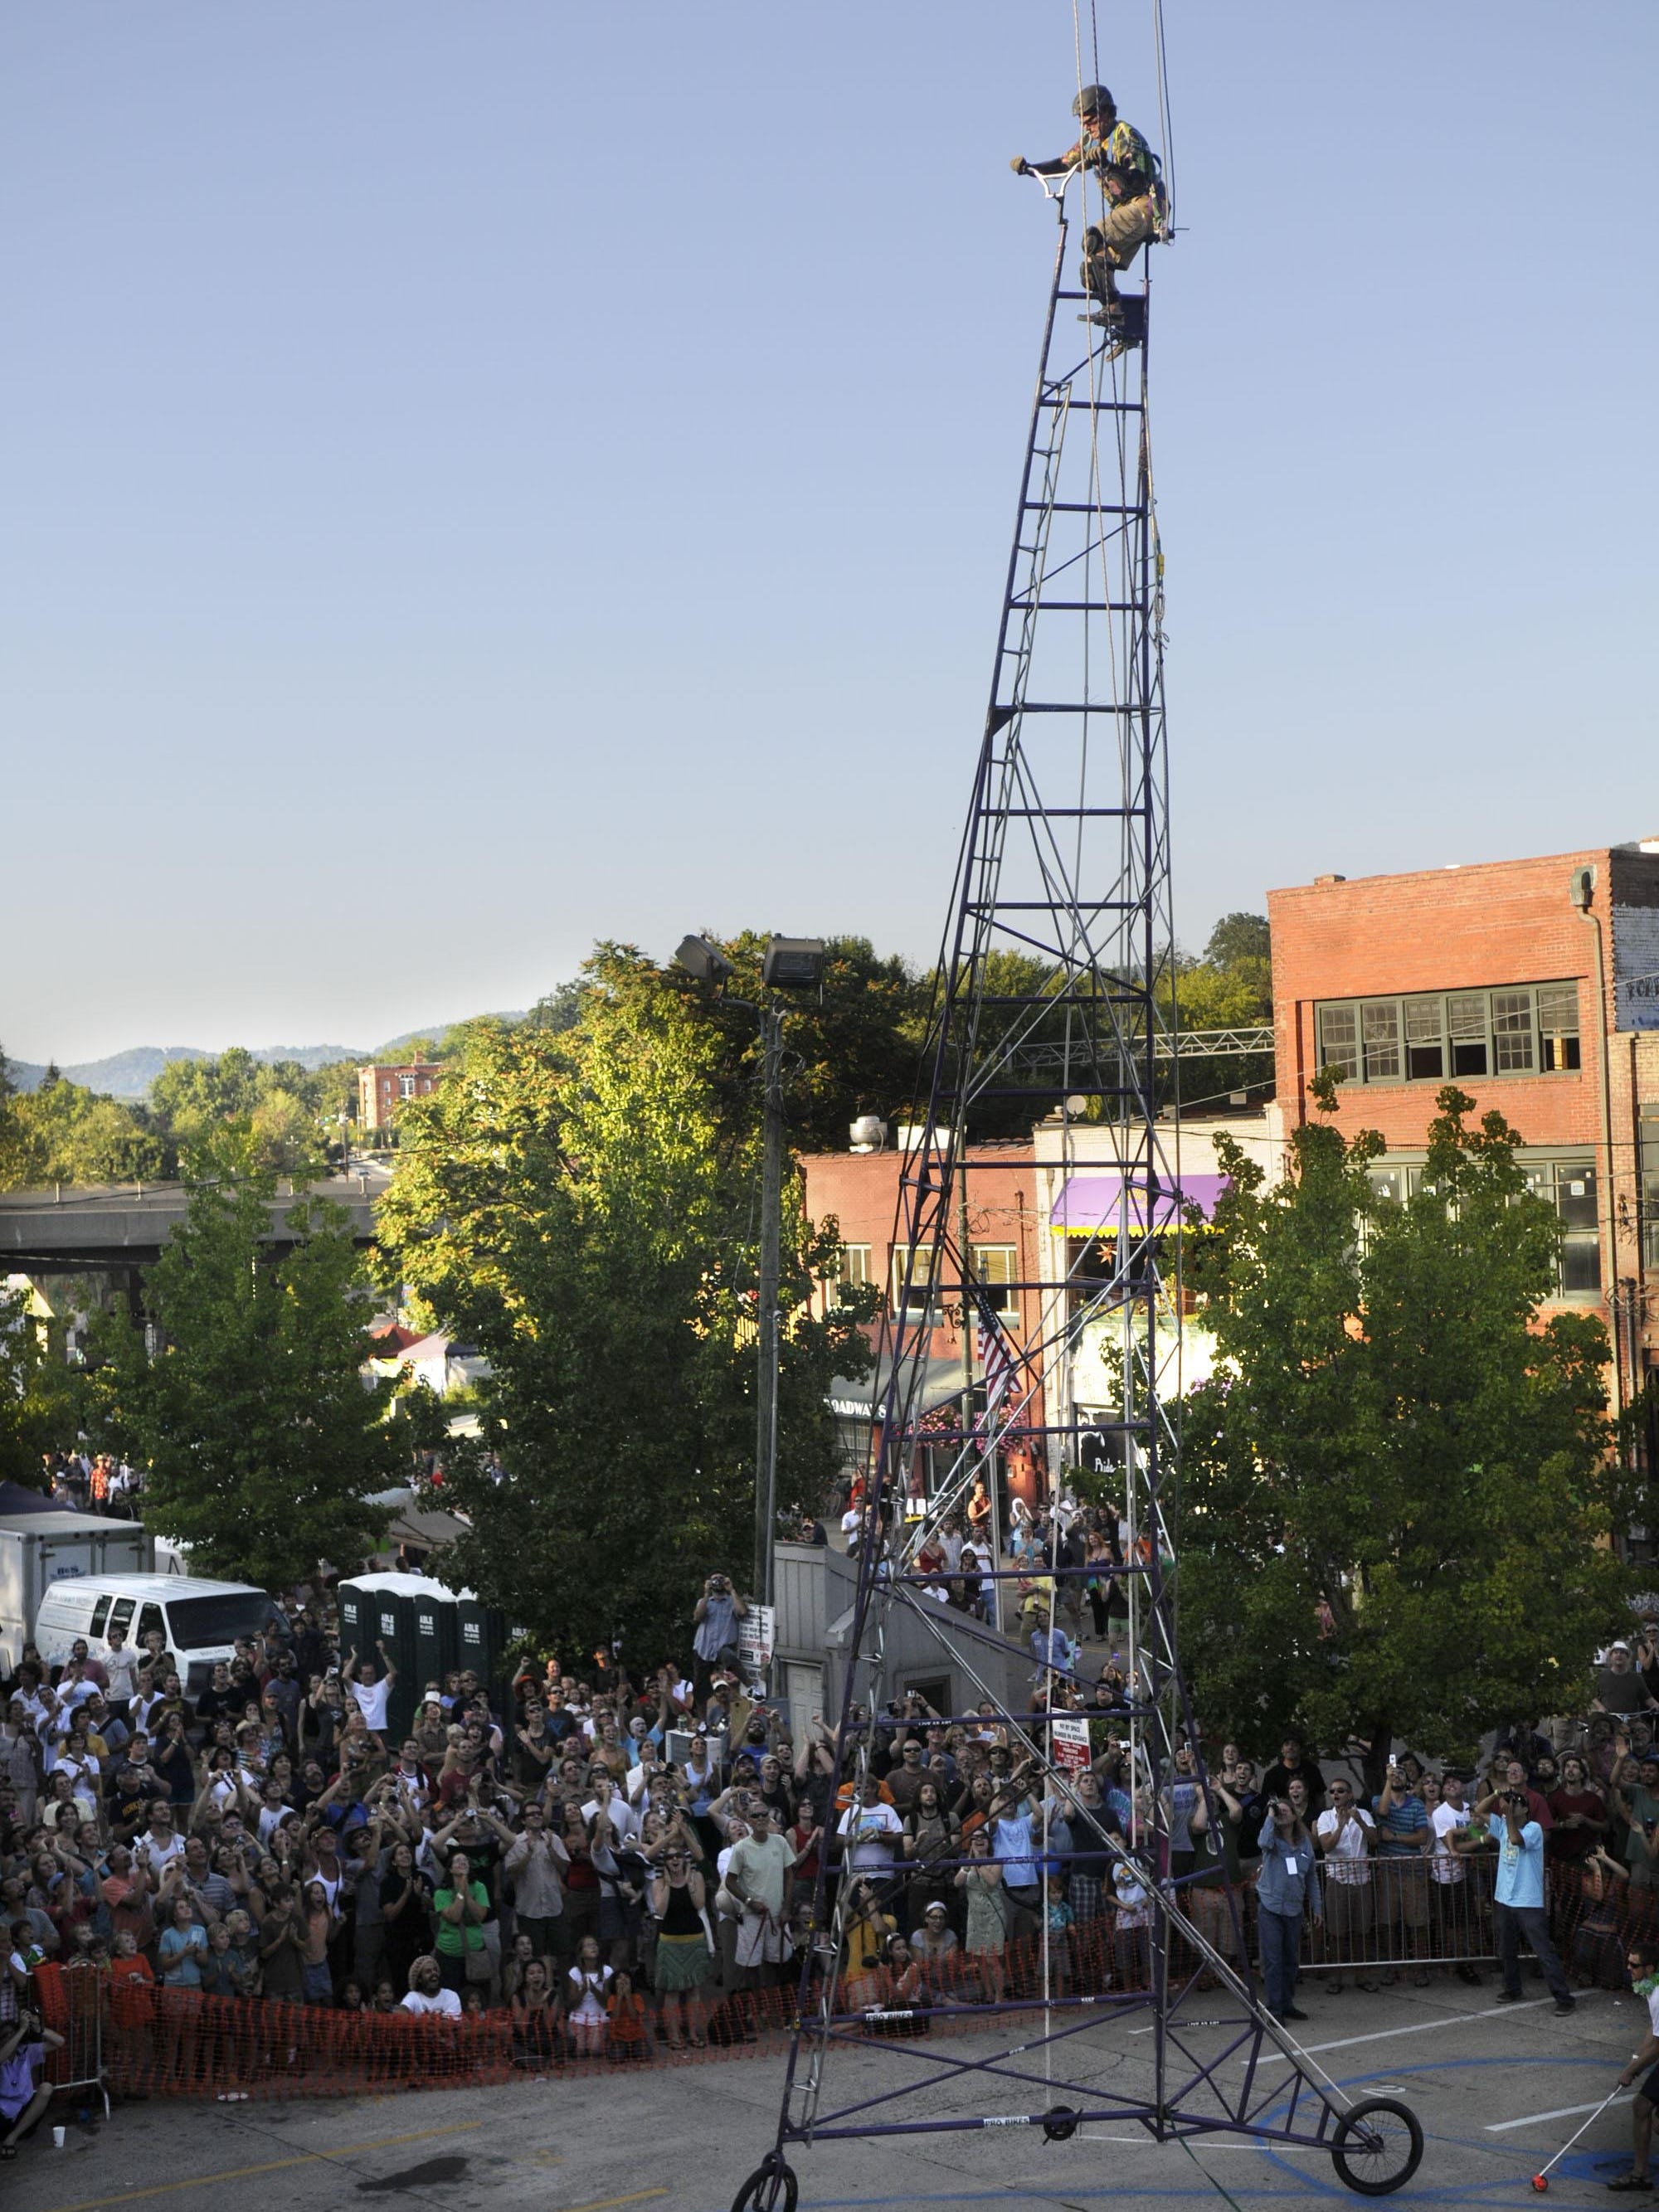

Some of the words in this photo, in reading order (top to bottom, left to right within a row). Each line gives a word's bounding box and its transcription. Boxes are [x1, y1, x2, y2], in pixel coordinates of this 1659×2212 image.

[344, 1604, 357, 1614] ABLE
[381, 1613, 395, 1623] ABLE
[419, 1615, 433, 1625] ABLE
[464, 1623, 479, 1633] ABLE
[888, 2012, 912, 2020] BIKES
[1005, 2117, 1029, 2127] BIKES
